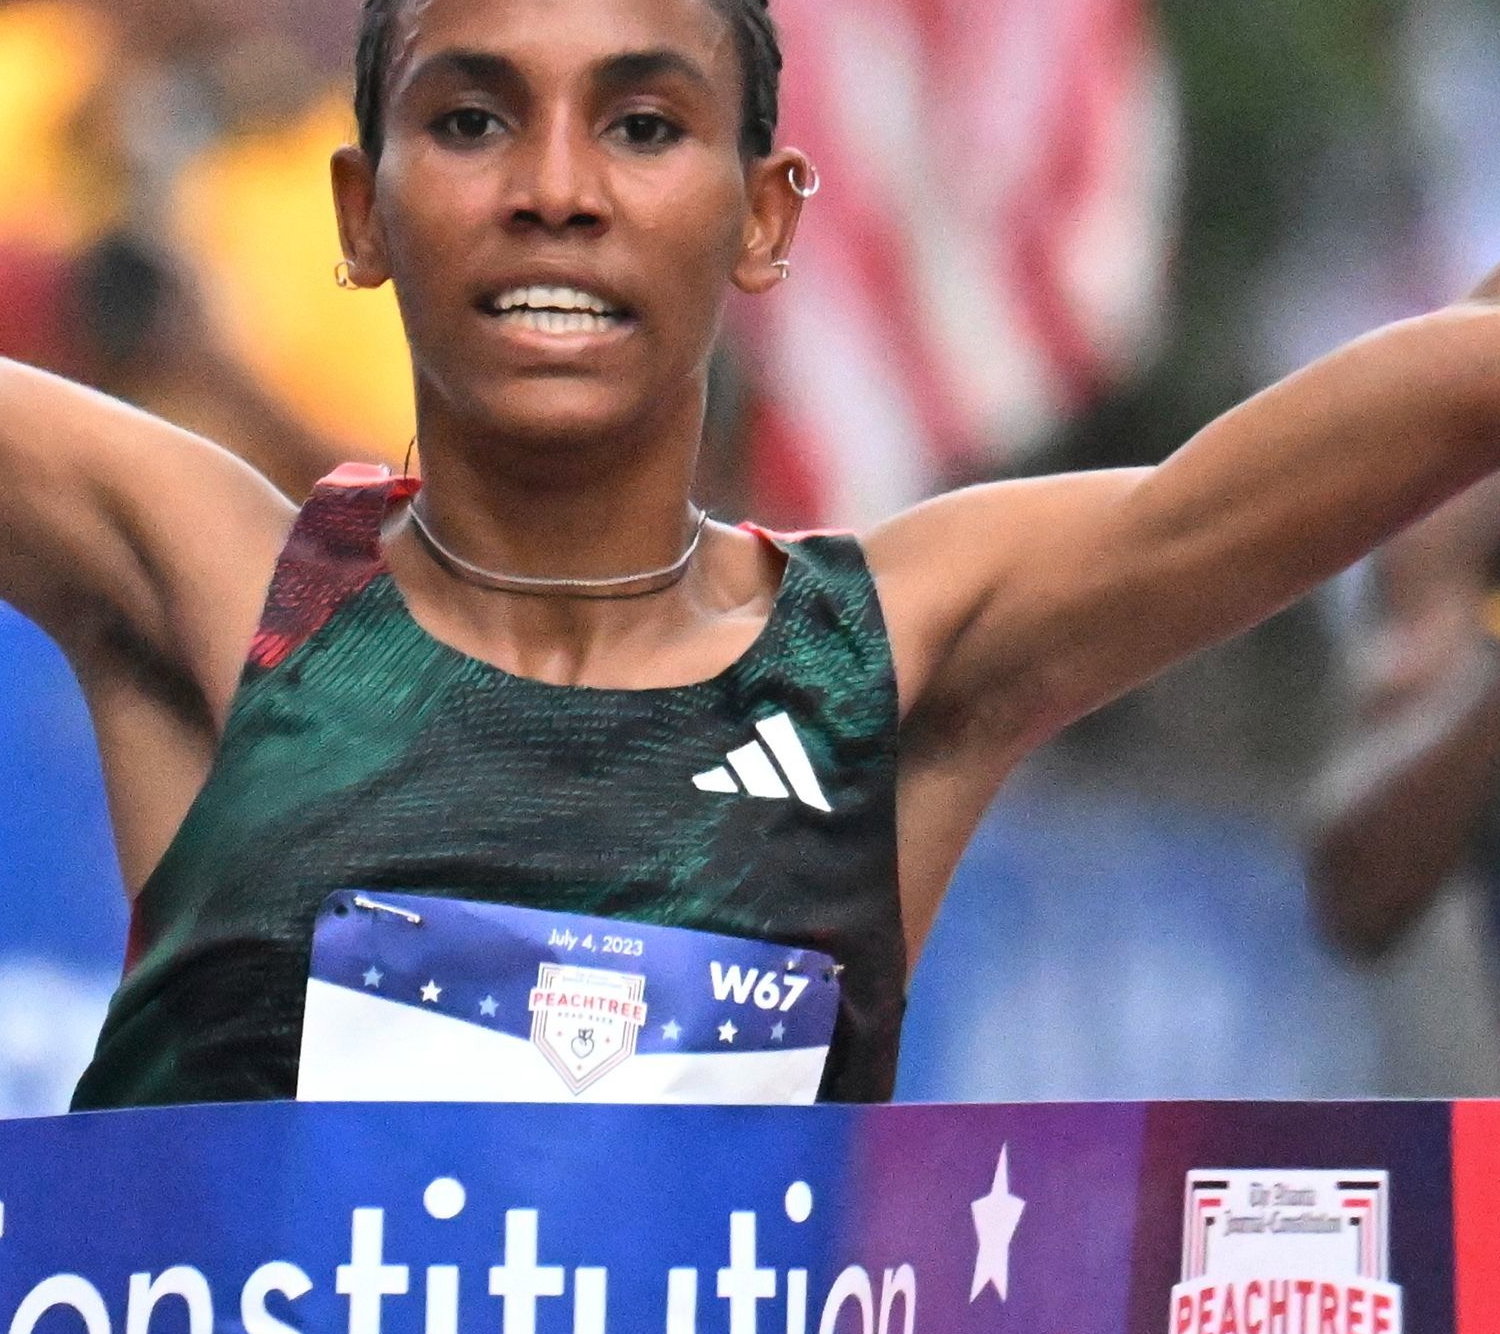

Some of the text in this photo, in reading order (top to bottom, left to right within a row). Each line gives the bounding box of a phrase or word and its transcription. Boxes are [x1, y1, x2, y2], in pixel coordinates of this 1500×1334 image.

[548, 928, 644, 957] July 4, 2023
[709, 960, 809, 1012] W67
[533, 991, 643, 1020] PEACHTREE
